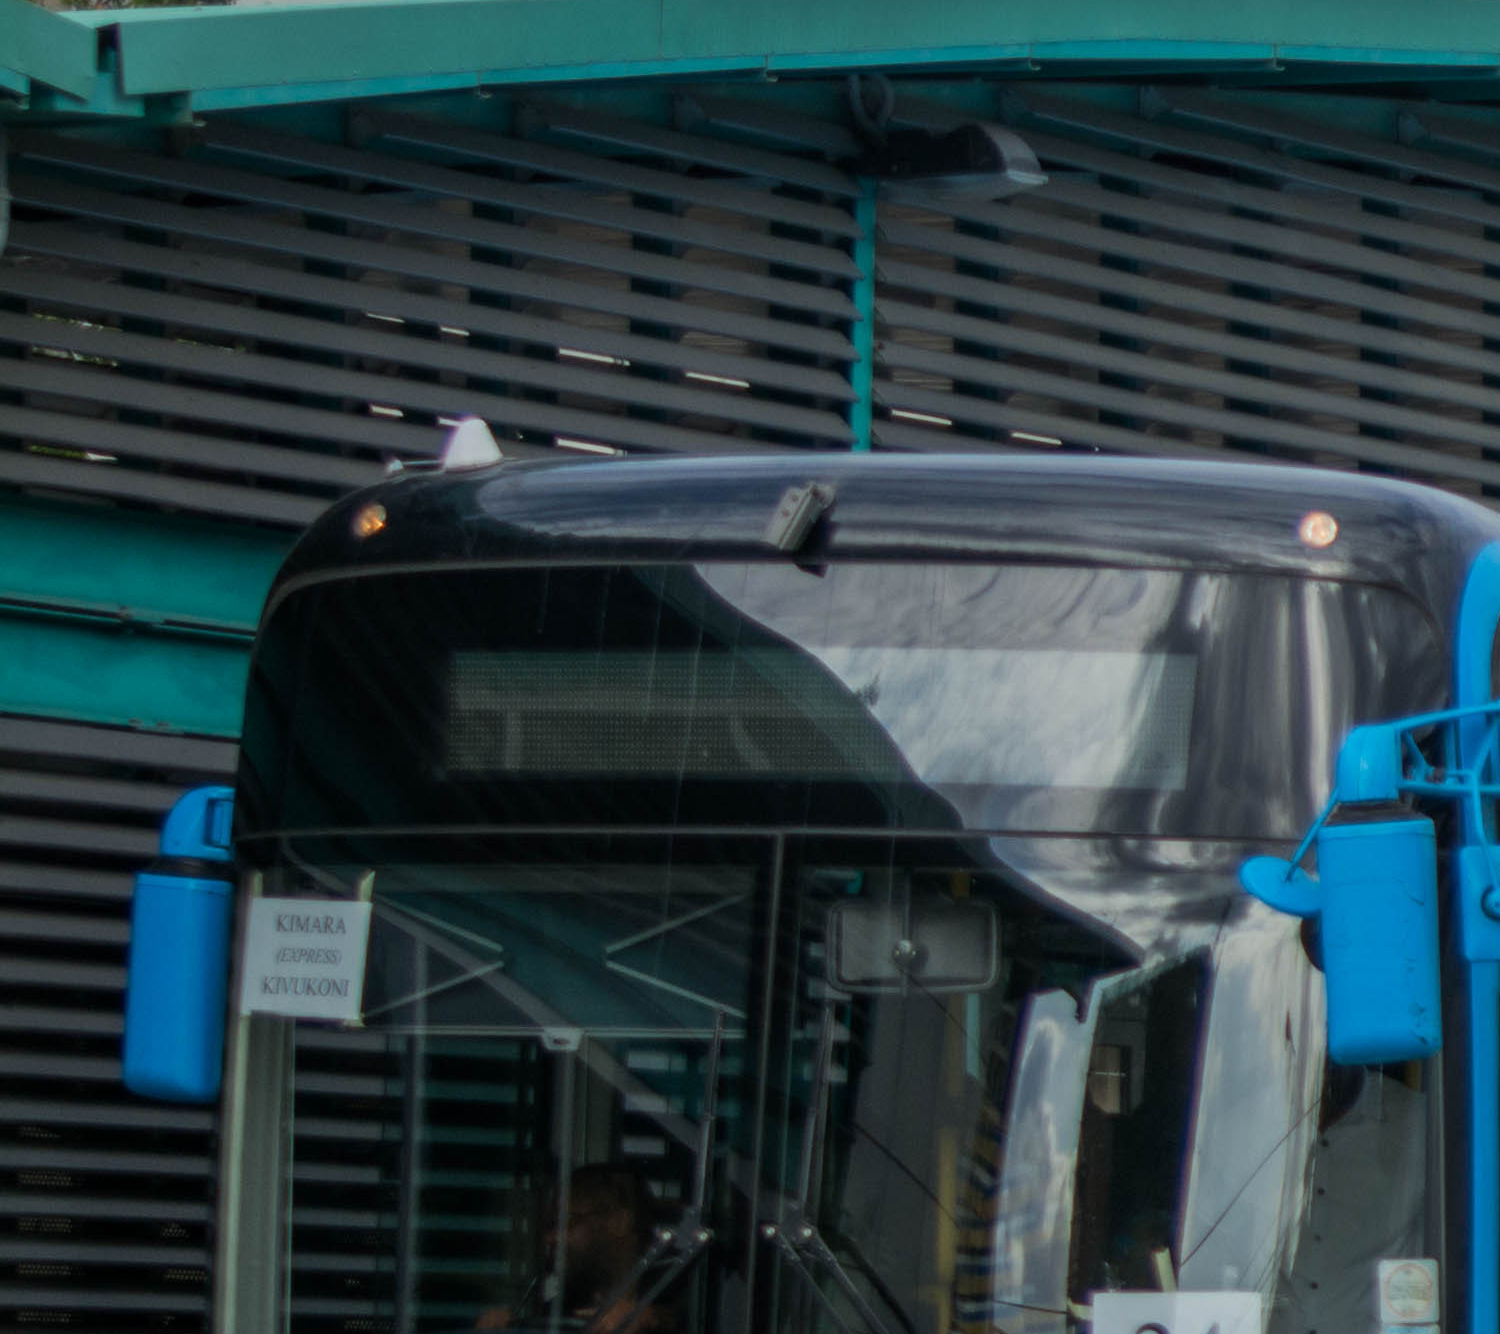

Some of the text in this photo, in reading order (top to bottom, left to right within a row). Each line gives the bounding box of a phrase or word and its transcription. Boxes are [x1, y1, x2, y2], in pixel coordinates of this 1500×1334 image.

[275, 913, 348, 935] KIMARA
[275, 946, 343, 966] (EXPRESS)
[262, 975, 352, 998] KIVUKONI
